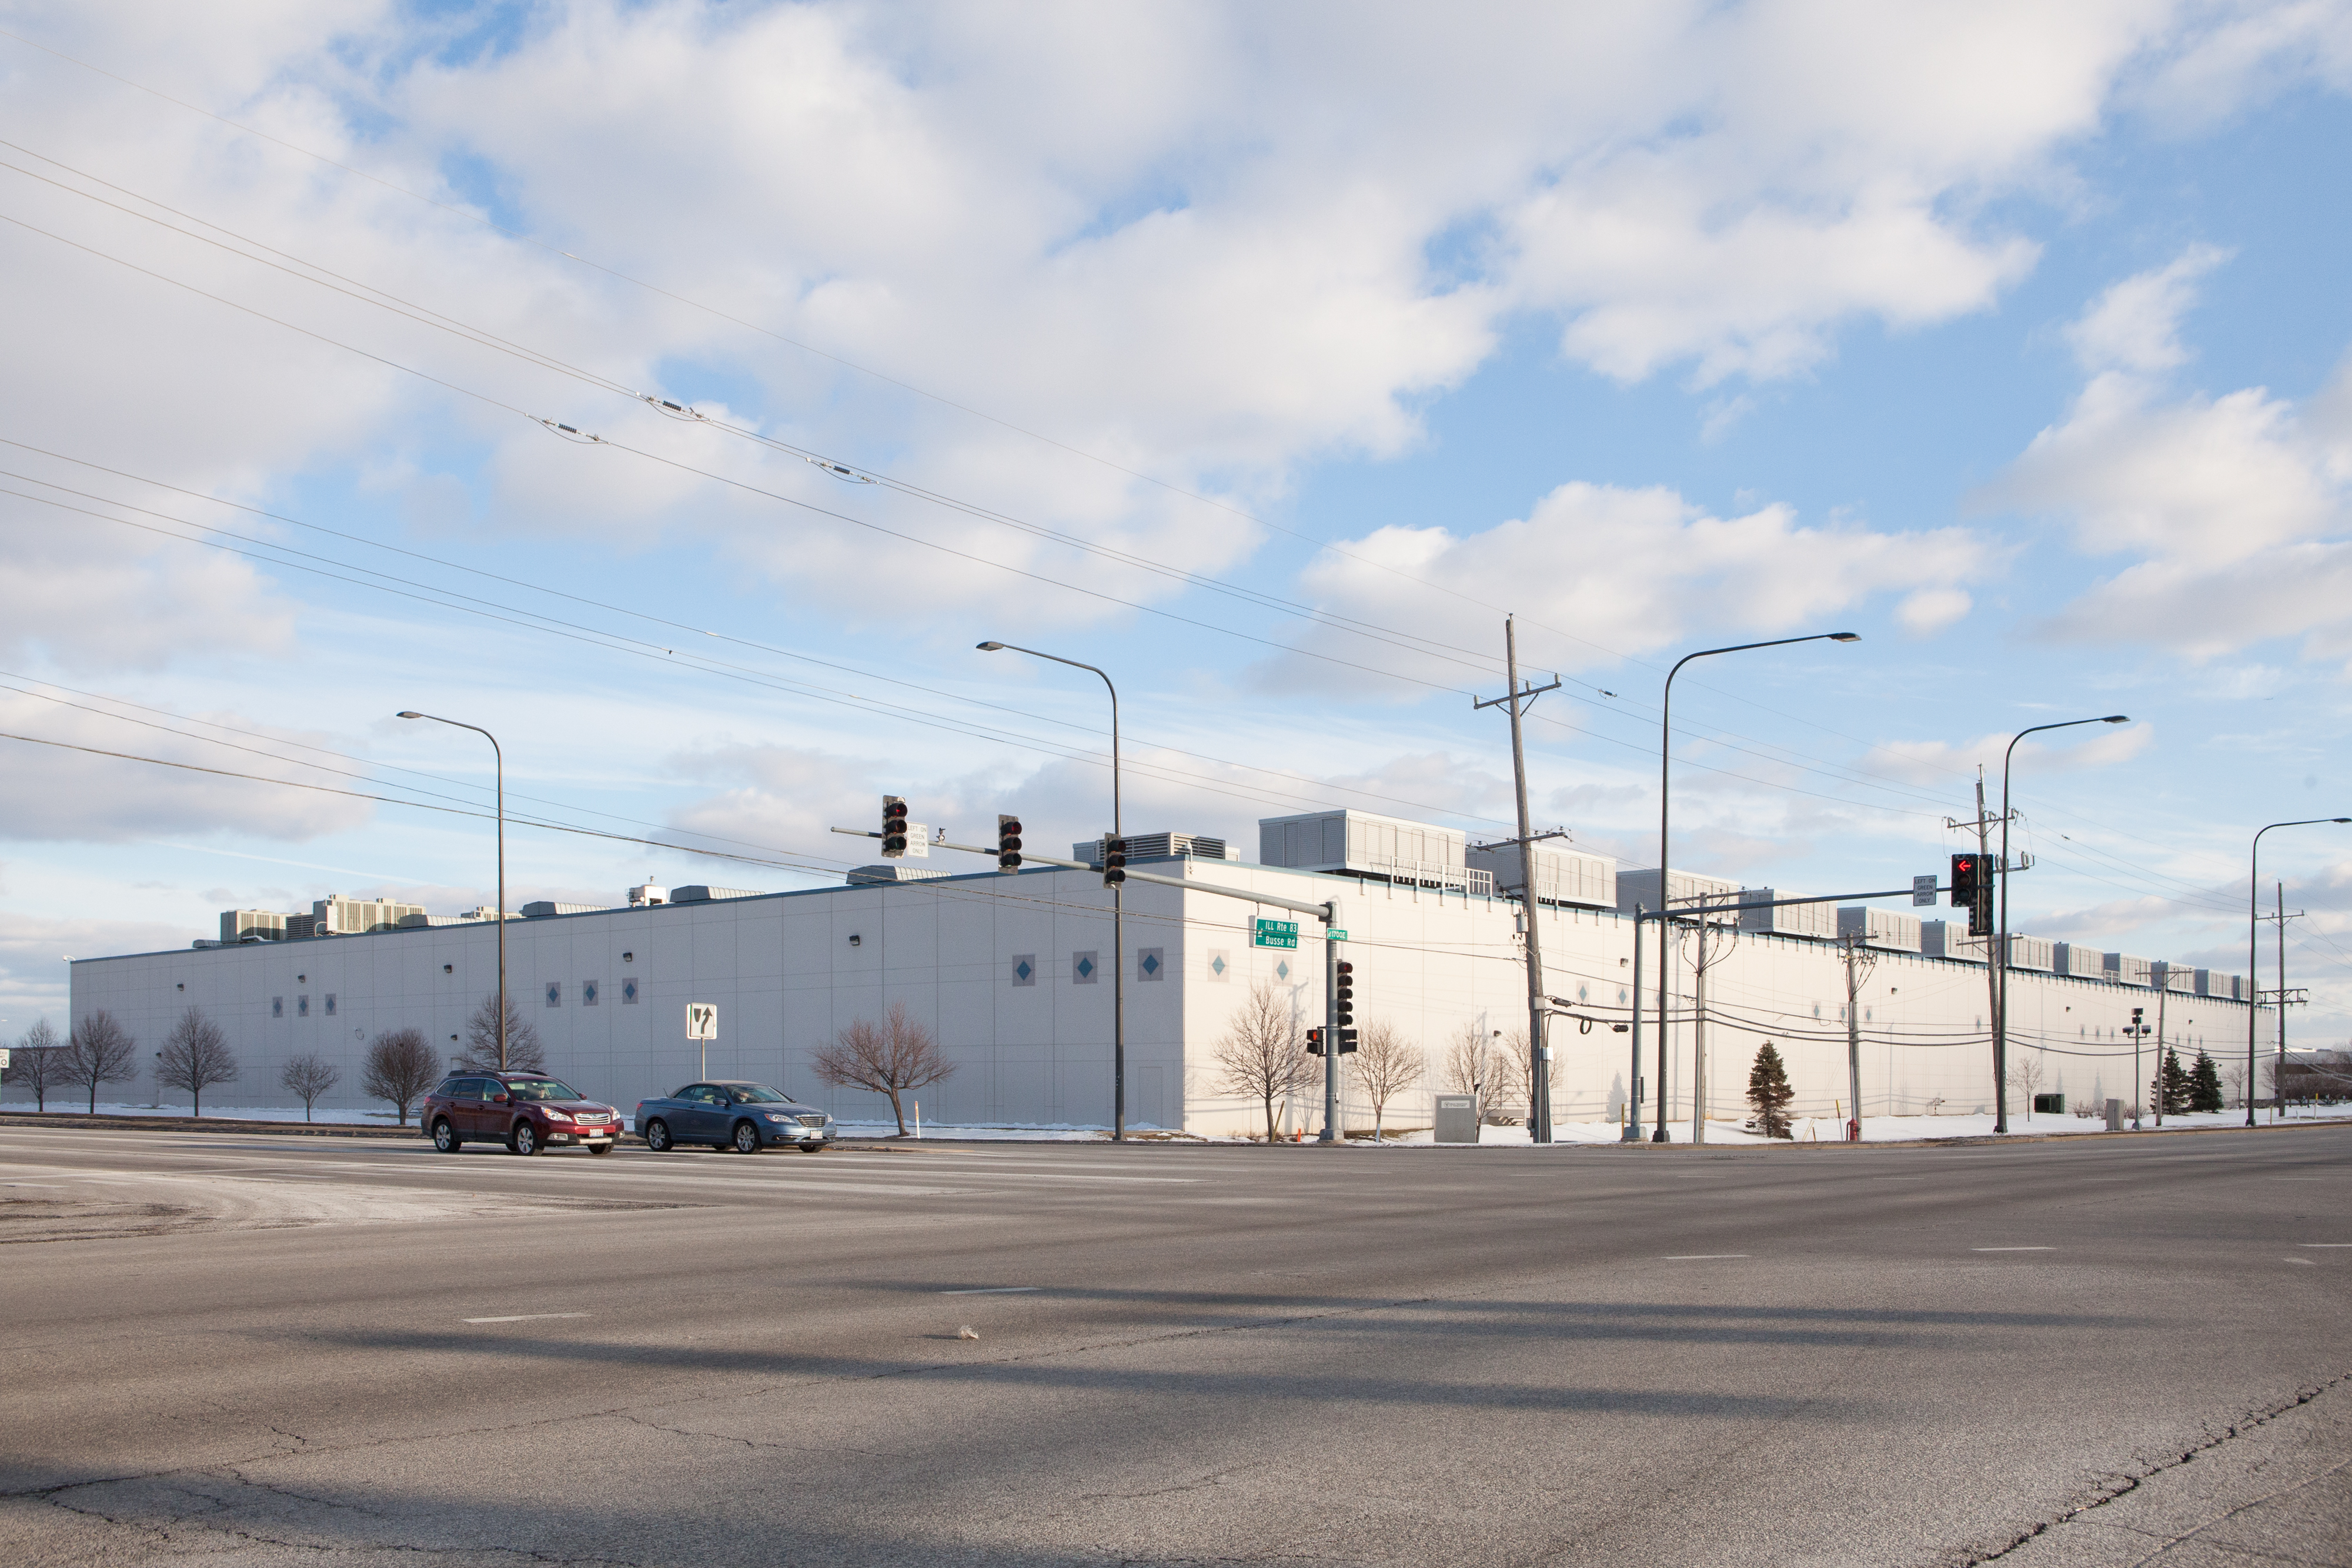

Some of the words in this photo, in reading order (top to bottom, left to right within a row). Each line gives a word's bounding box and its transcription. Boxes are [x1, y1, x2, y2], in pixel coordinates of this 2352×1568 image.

[1265, 921, 1274, 931] ILL
[1277, 922, 1287, 932] Rte
[1289, 923, 1297, 933] 83
[1265, 935, 1284, 946] Busse
[1287, 937, 1295, 947] Rd
[1331, 931, 1346, 939] 1700E
